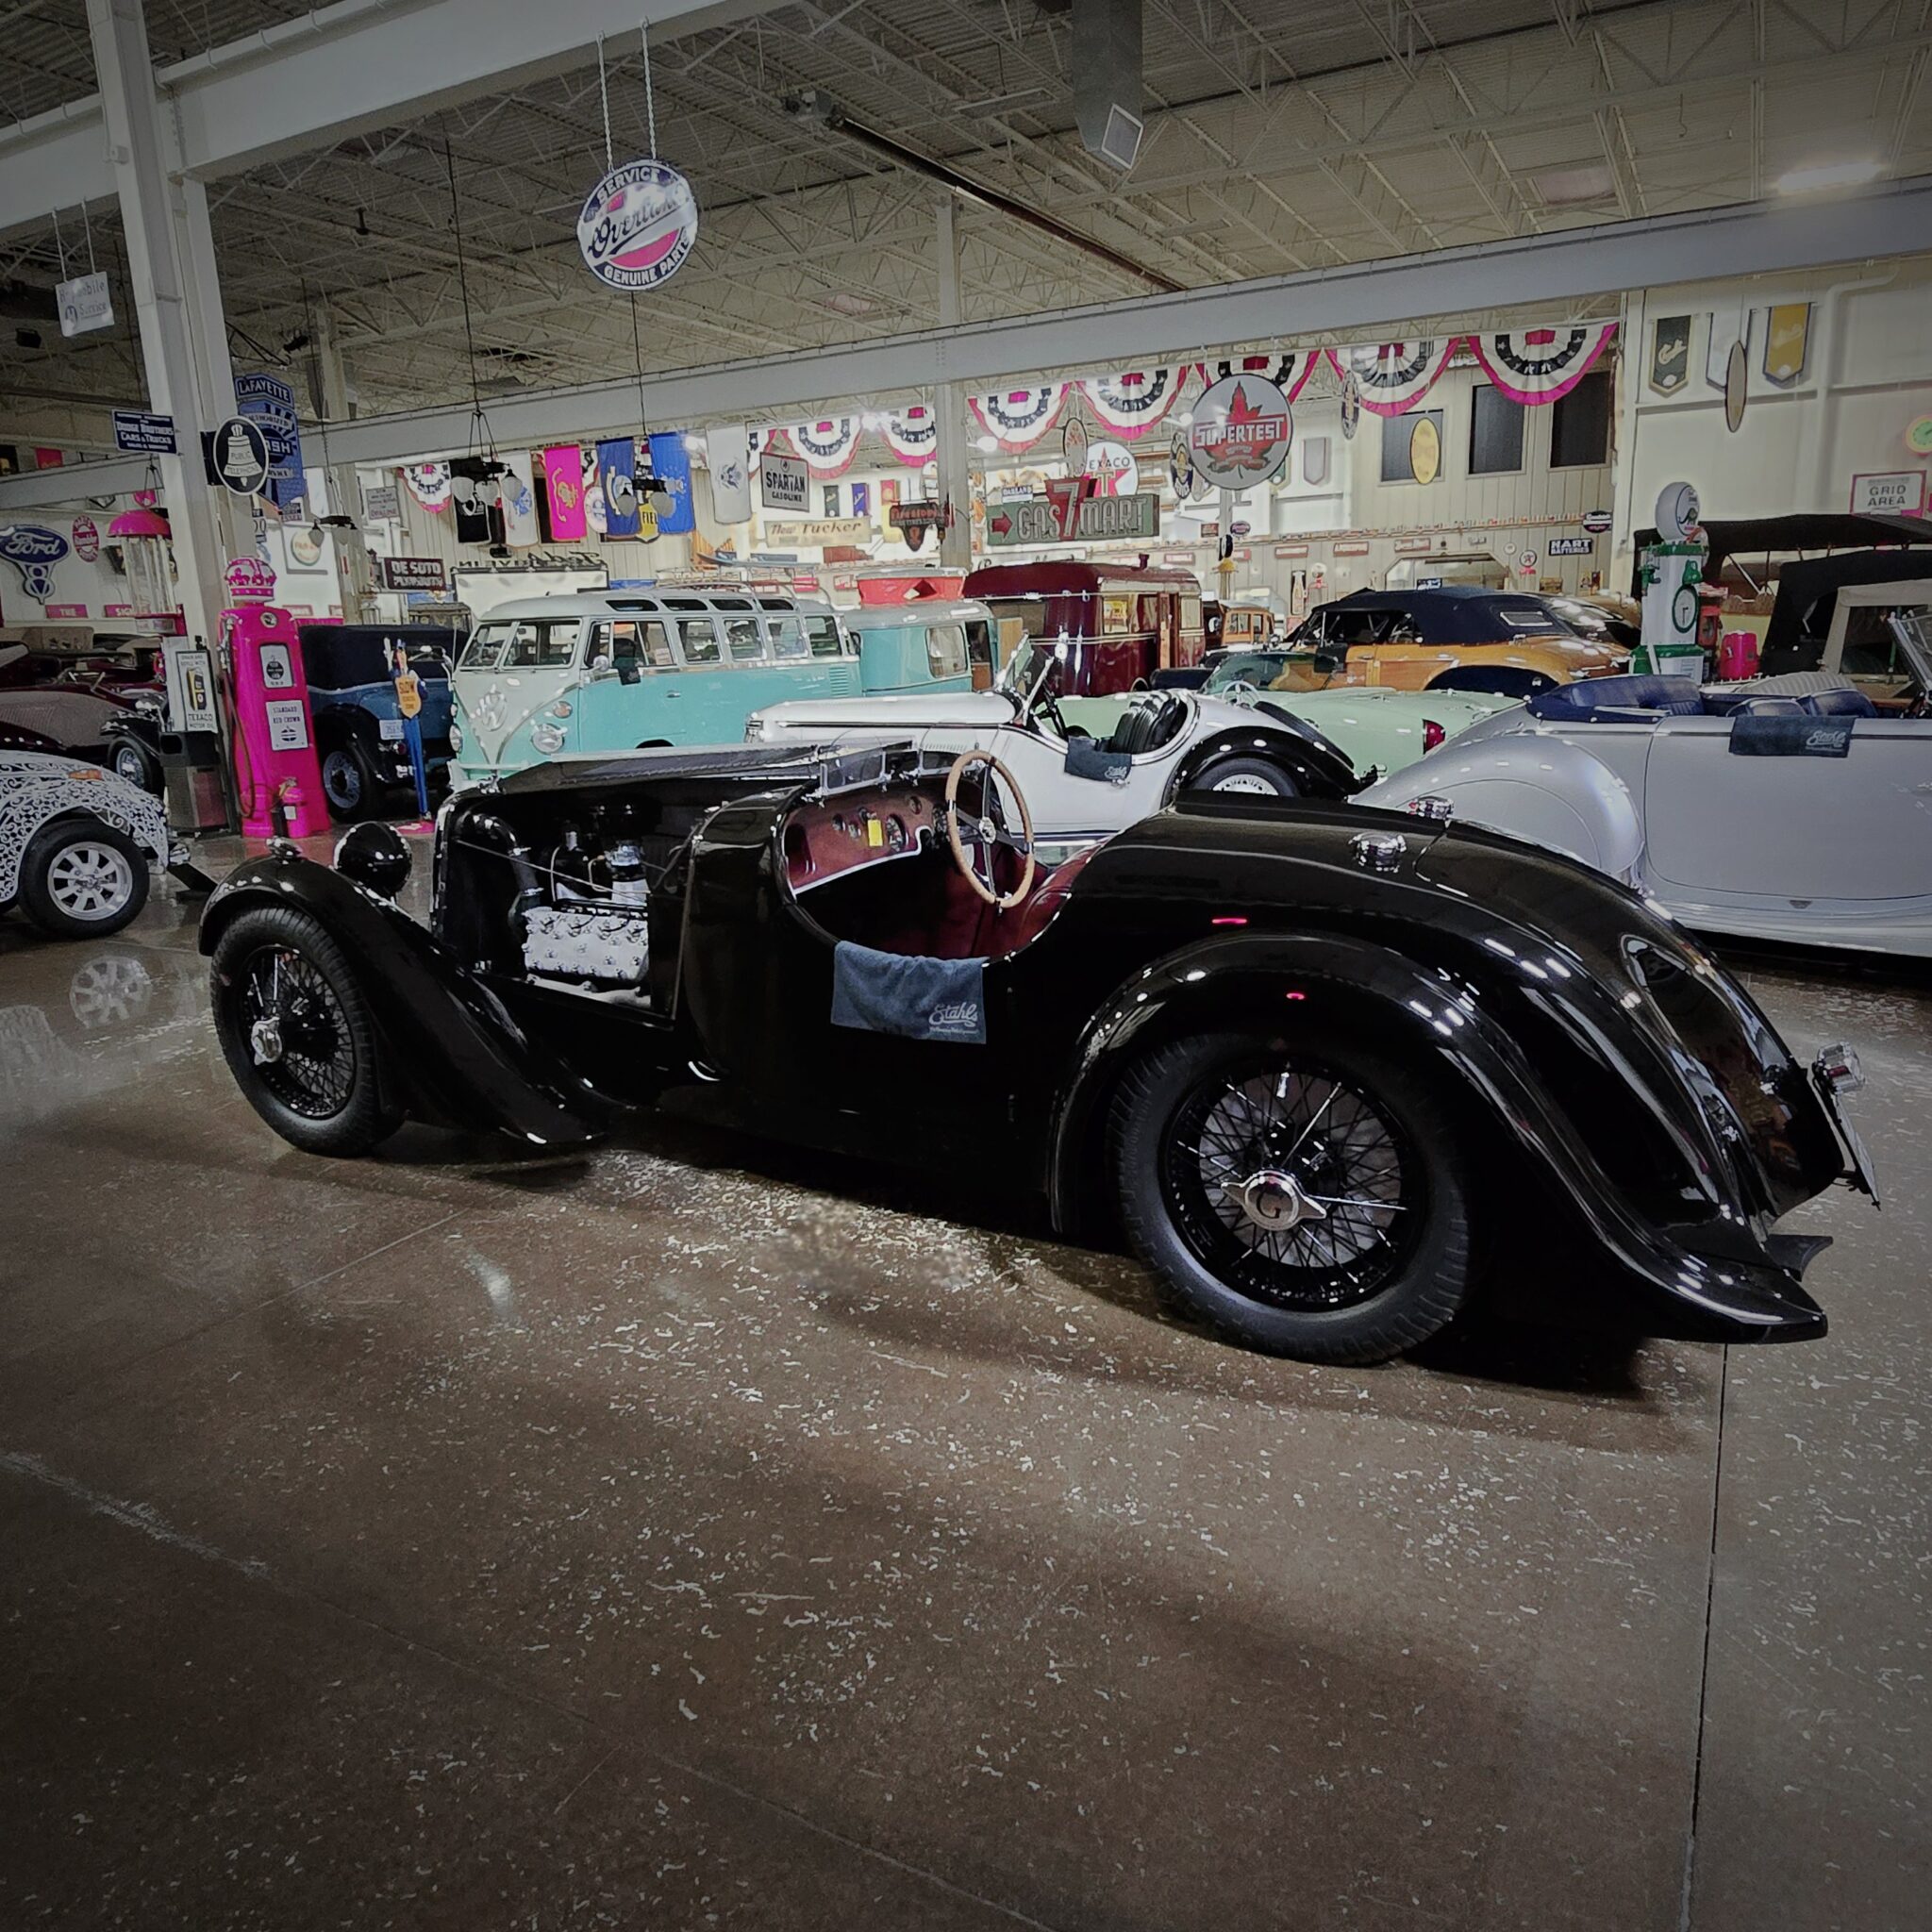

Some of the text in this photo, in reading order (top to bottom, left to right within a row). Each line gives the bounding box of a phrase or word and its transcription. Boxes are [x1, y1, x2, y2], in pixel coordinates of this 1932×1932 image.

[596, 166, 660, 206] SERVICE
[659, 229, 690, 275] PARTS
[605, 264, 658, 285] GENUINE
[1194, 417, 1284, 447] SUPERTEST
[265, 440, 291, 454] ASH
[230, 451, 253, 461] PUBLIC
[1089, 456, 1131, 470] EXACO
[226, 463, 259, 475] TELEPHONE
[765, 471, 806, 492] SPARTAN
[772, 491, 803, 503] GASOLINE
[1869, 484, 1907, 496] GRID
[1867, 495, 1906, 507] AREA
[642, 511, 658, 525] FIEL
[1018, 482, 1147, 540] GAS 7 MART
[803, 522, 862, 535] Tucker
[5, 531, 60, 555] Ford
[1551, 539, 1591, 548] HART
[1550, 546, 1591, 555] BATTERIES
[391, 560, 441, 575] DE SOTO
[188, 713, 213, 722] TEXACO
[928, 1002, 978, 1027] Stahls
